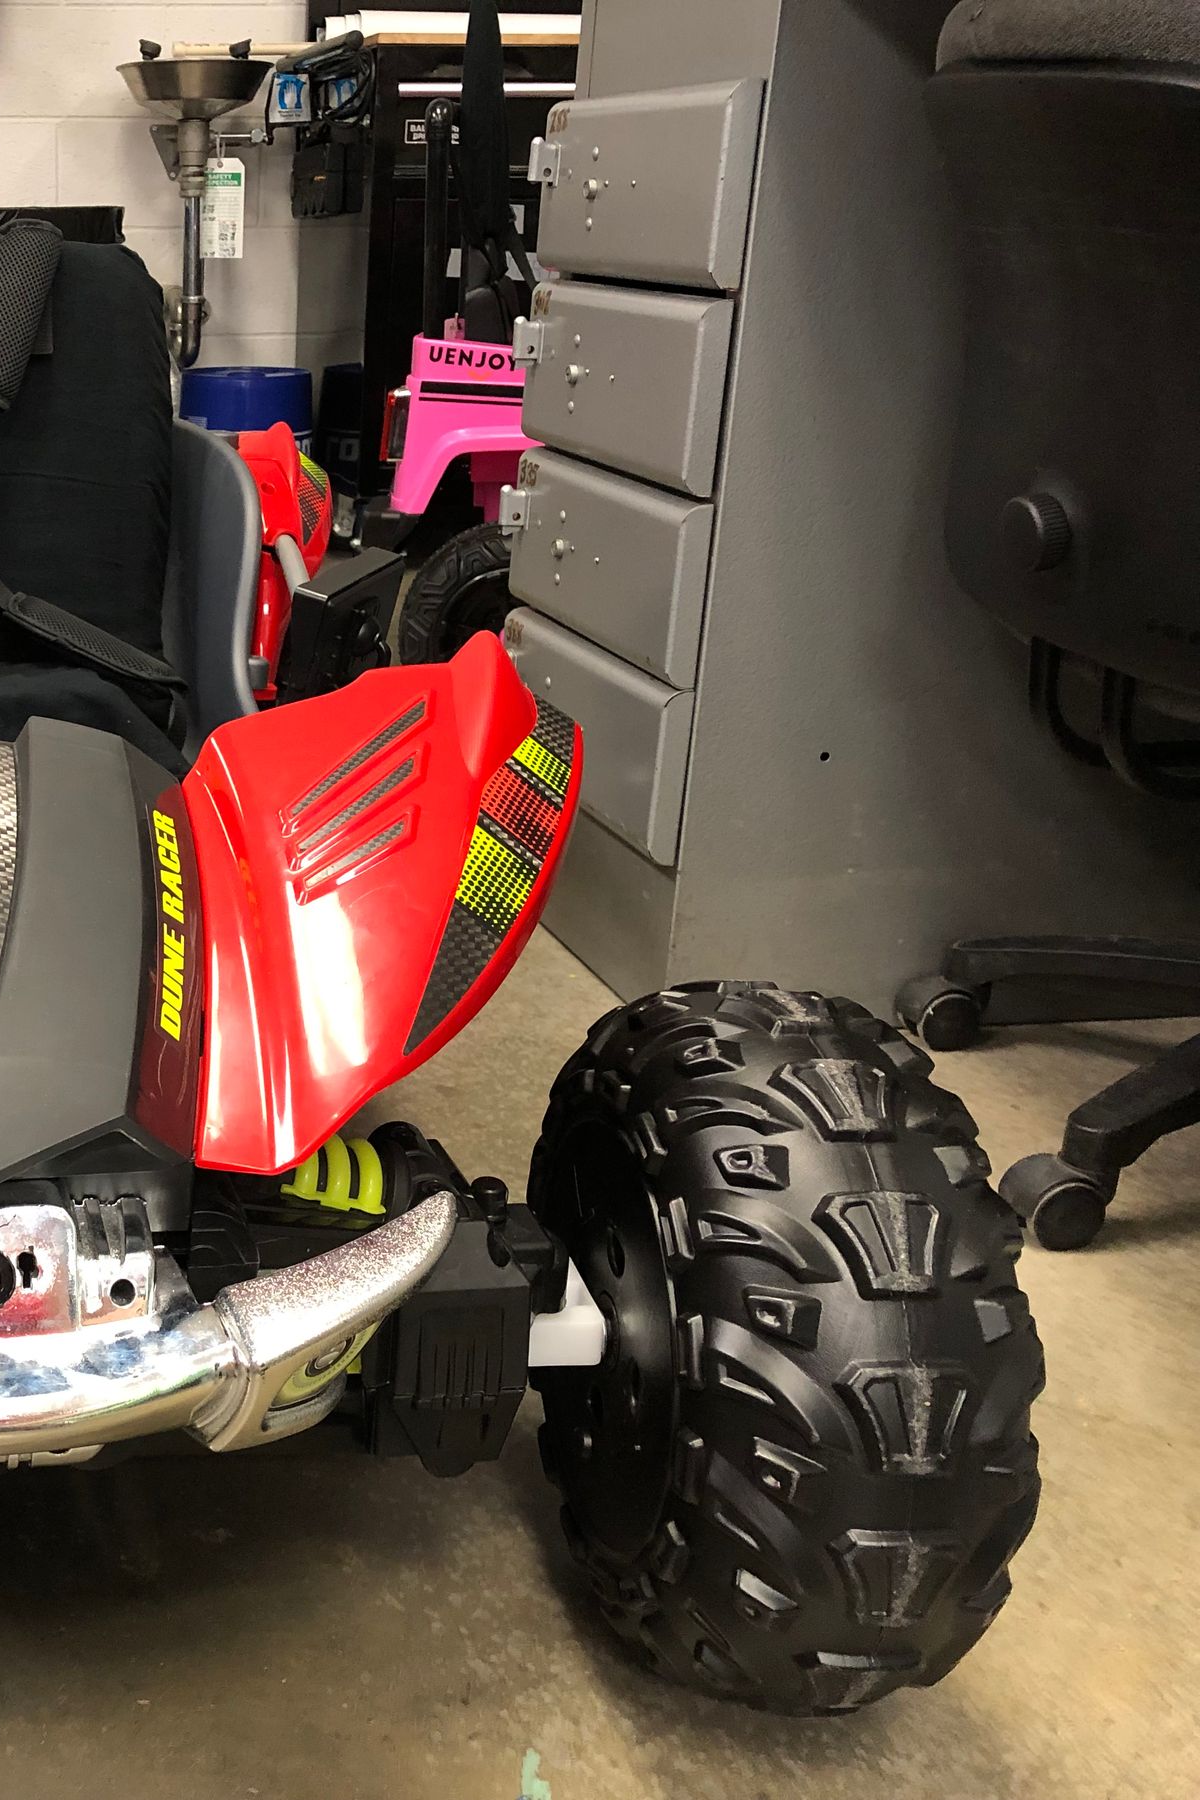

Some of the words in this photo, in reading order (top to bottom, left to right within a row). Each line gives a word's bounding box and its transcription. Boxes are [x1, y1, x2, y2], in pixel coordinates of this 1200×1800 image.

[429, 345, 516, 371] UENJOY
[152, 809, 185, 924] RACER
[160, 922, 185, 1042] DUNE
